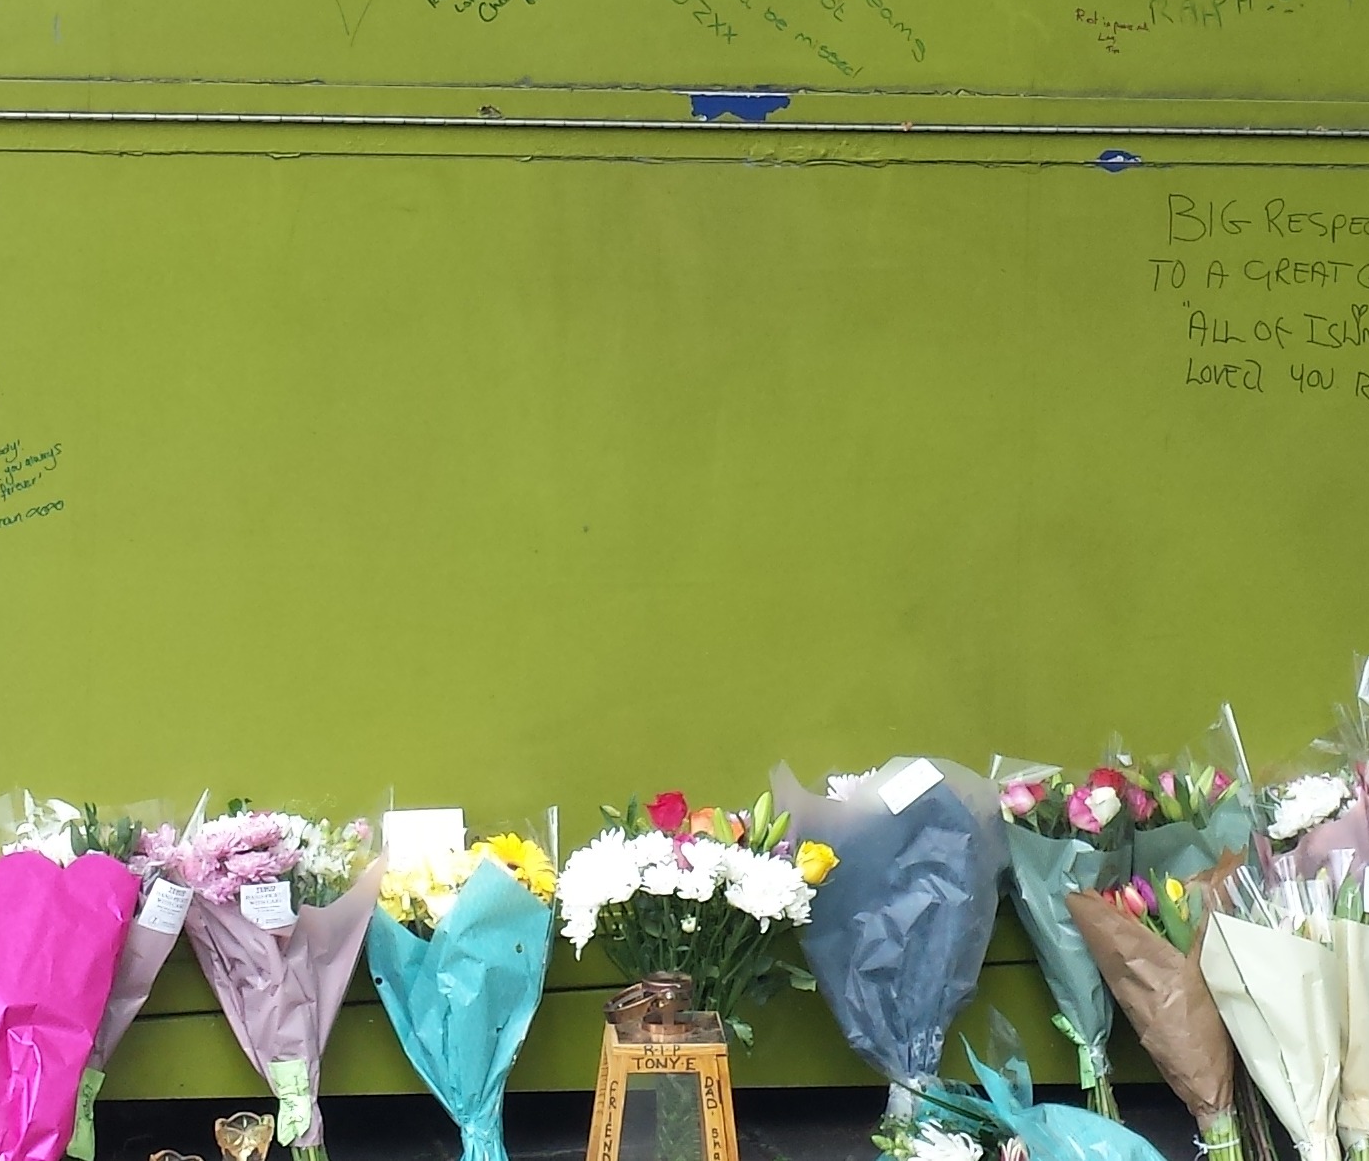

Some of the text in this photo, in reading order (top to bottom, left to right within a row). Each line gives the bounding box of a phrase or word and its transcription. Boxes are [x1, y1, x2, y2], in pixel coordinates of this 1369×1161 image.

[1167, 192, 1253, 246] BIG
[1148, 257, 1187, 292] TO
[1205, 260, 1231, 291] A
[1243, 257, 1354, 293] GREAT
[1253, 315, 1293, 350] OF
